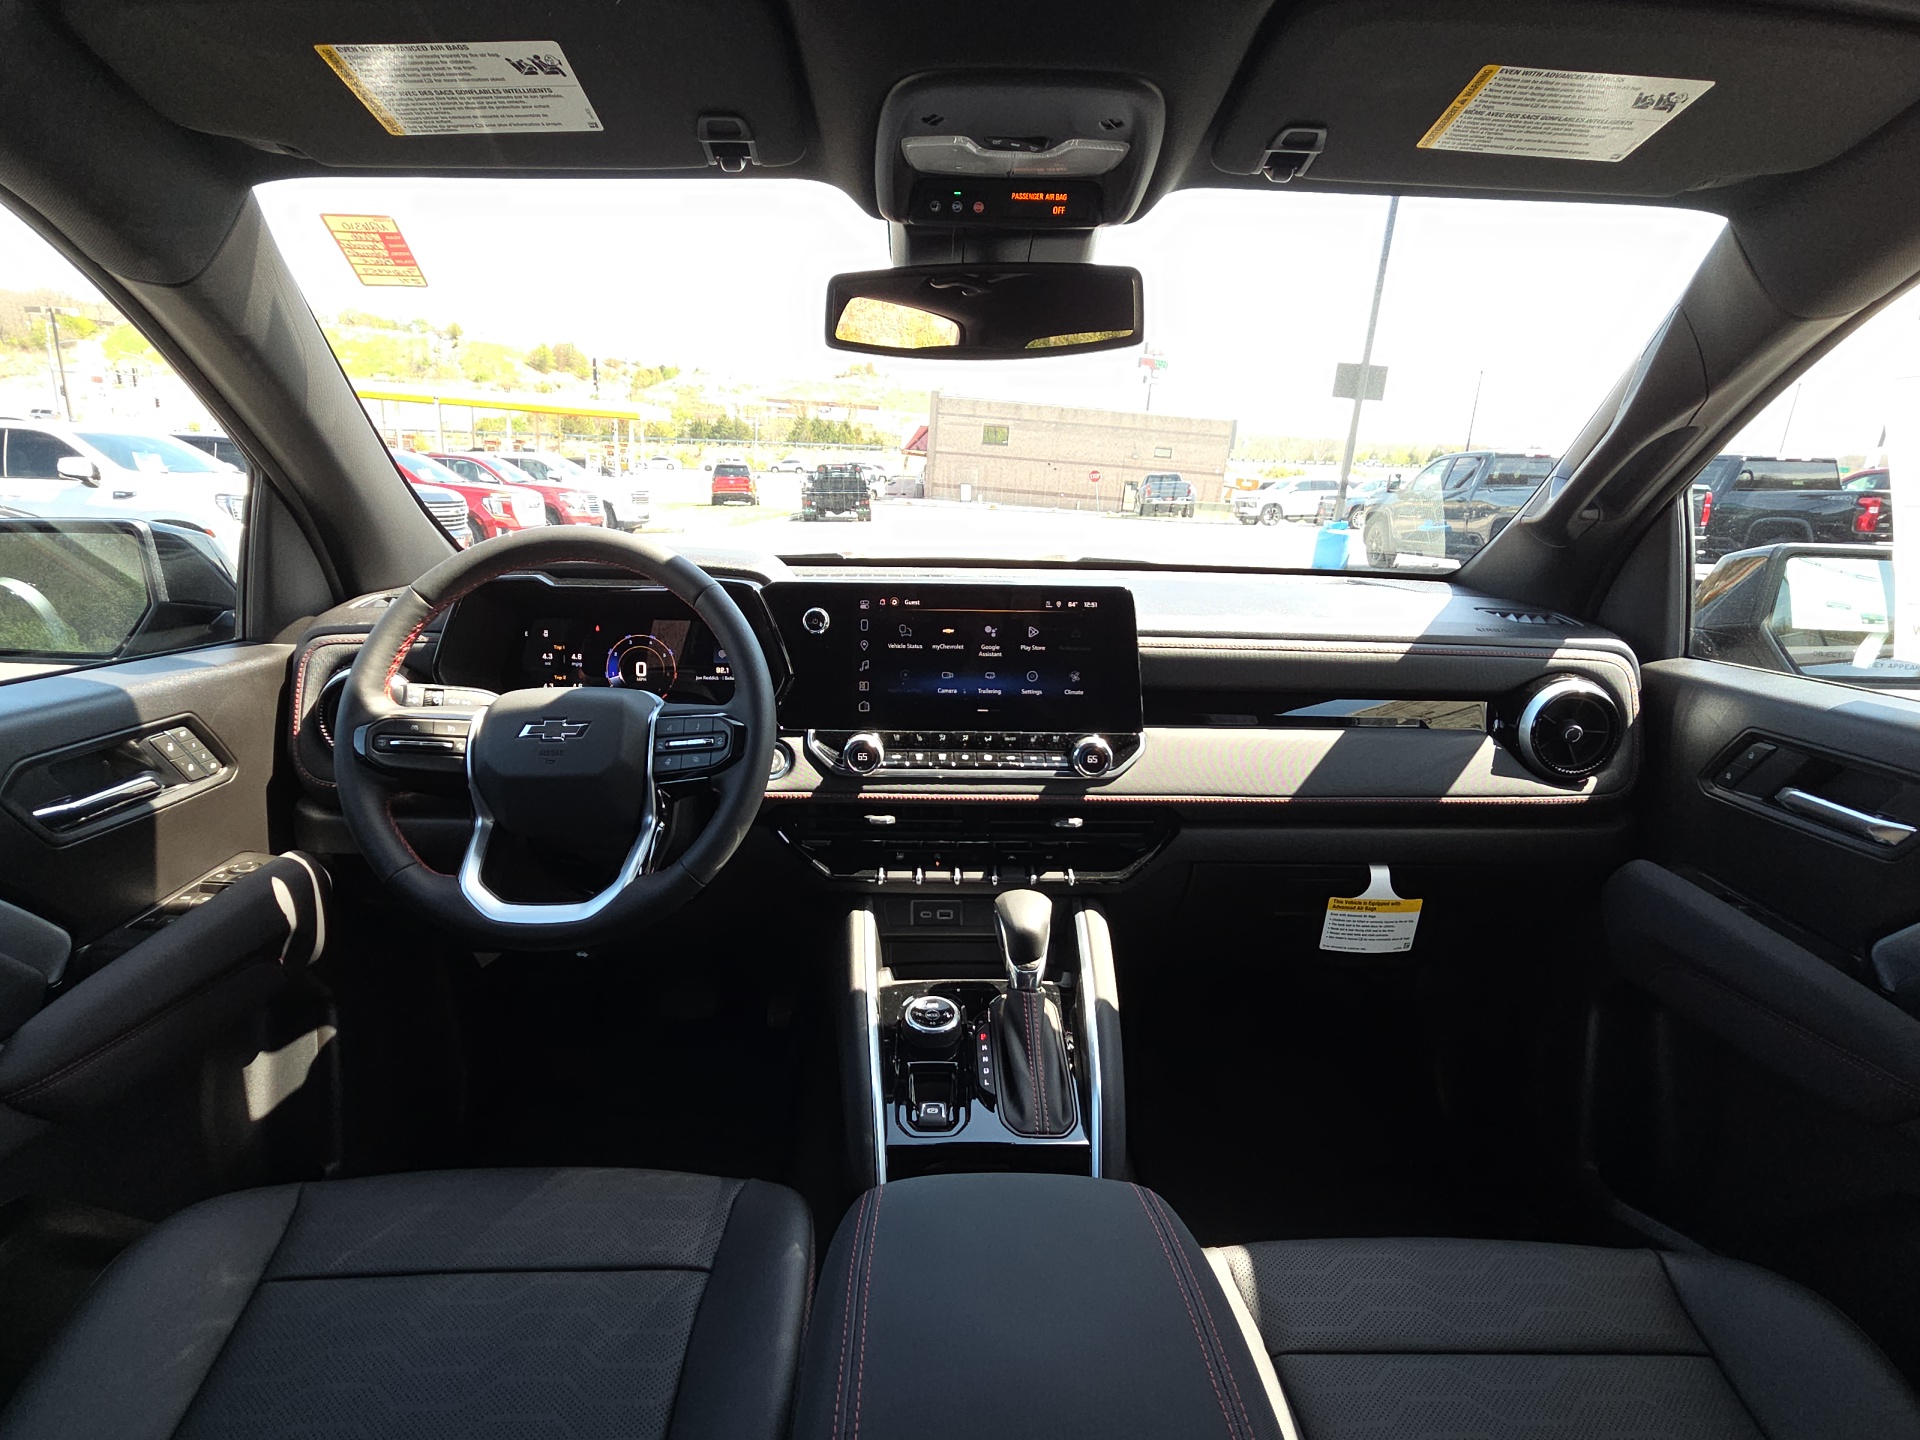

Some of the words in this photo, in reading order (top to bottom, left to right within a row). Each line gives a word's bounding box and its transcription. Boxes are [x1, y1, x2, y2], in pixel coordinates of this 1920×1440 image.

[1498, 68, 1522, 76] EVEN
[1544, 72, 1588, 80] ADVANCED
[1011, 192, 1044, 200] PASSENGER
[1052, 206, 1066, 214] OFF
[1812, 650, 1846, 658] OBJECTS
[636, 662, 647, 677] 0
[858, 752, 868, 762] 65
[1087, 755, 1097, 764] 65
